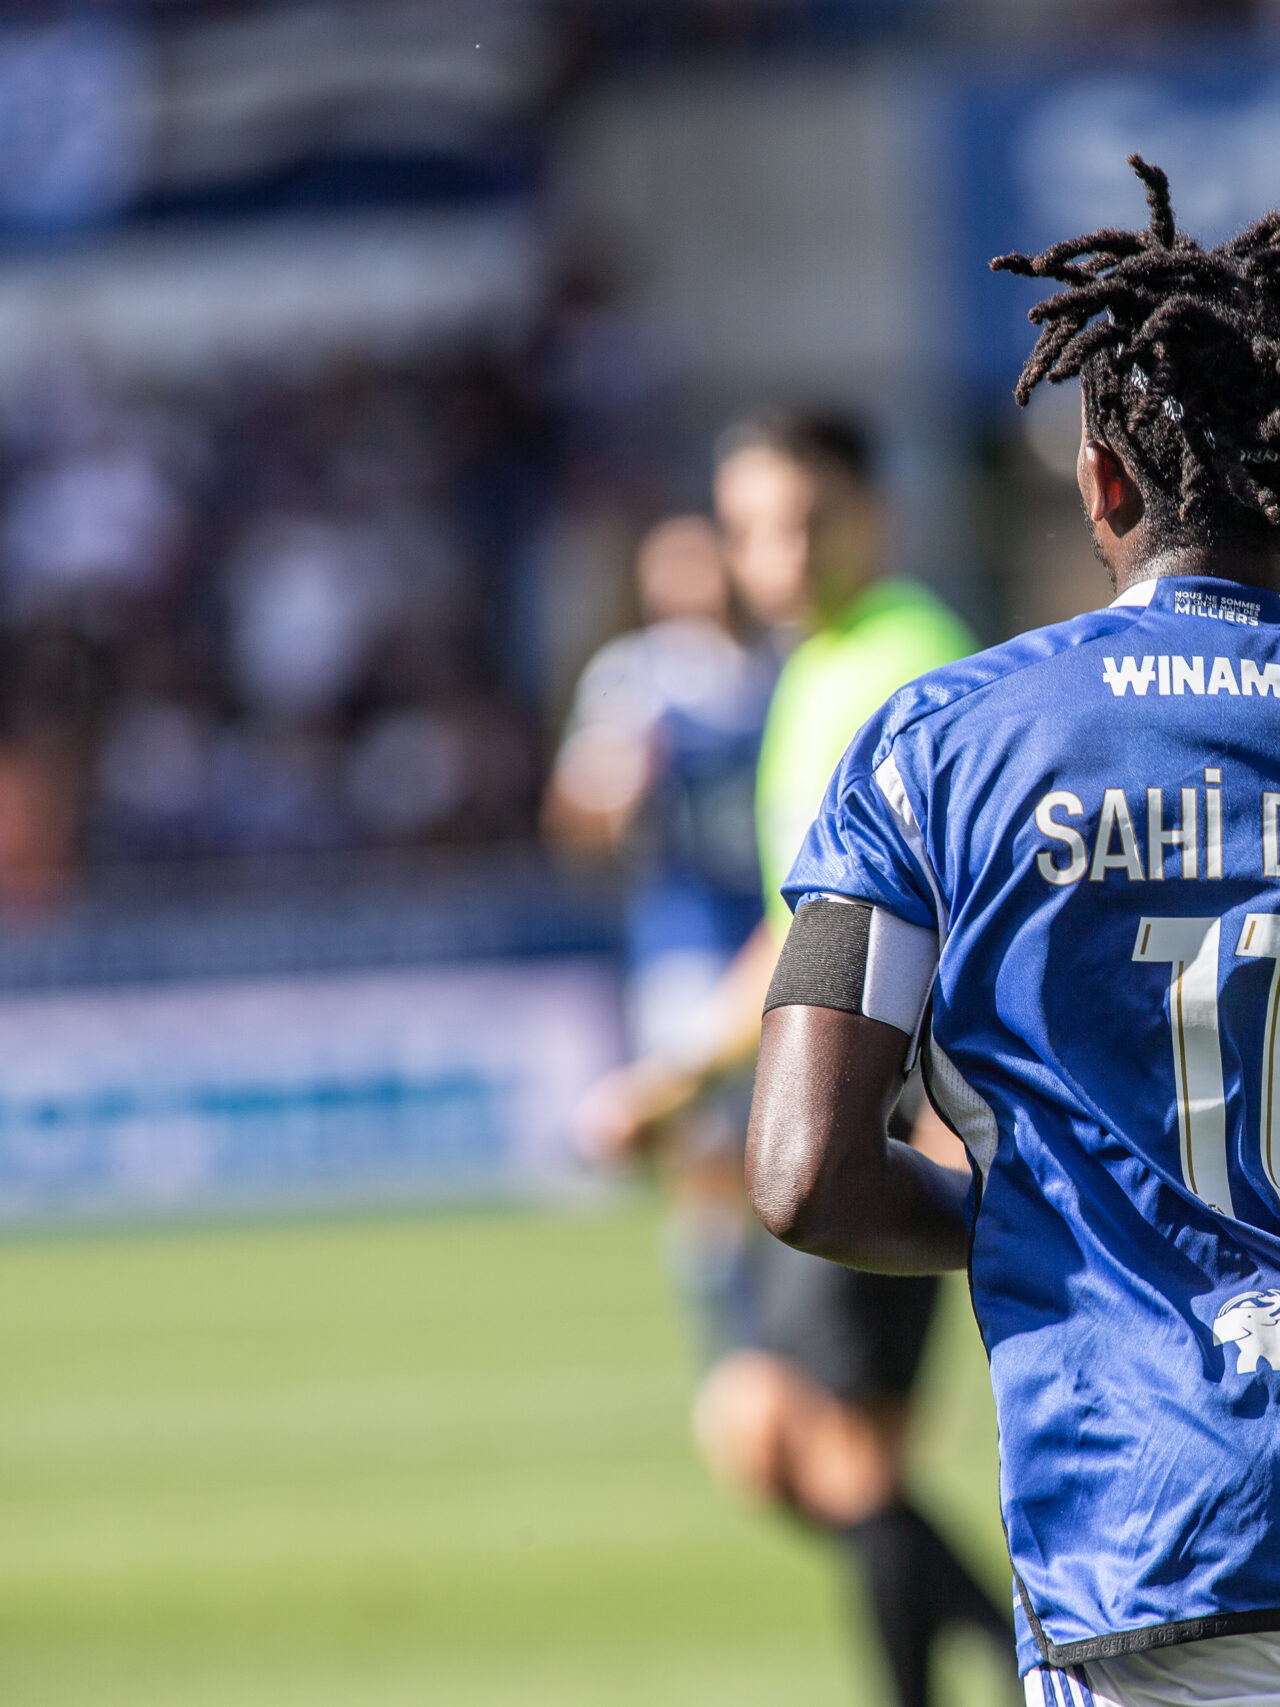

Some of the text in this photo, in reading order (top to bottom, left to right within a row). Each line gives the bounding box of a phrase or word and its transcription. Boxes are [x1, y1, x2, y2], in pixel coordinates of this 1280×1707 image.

[1174, 590, 1261, 611] NOUS NE SOMMES
[1174, 602, 1259, 626] MILLIERS
[1243, 608, 1259, 617] DES
